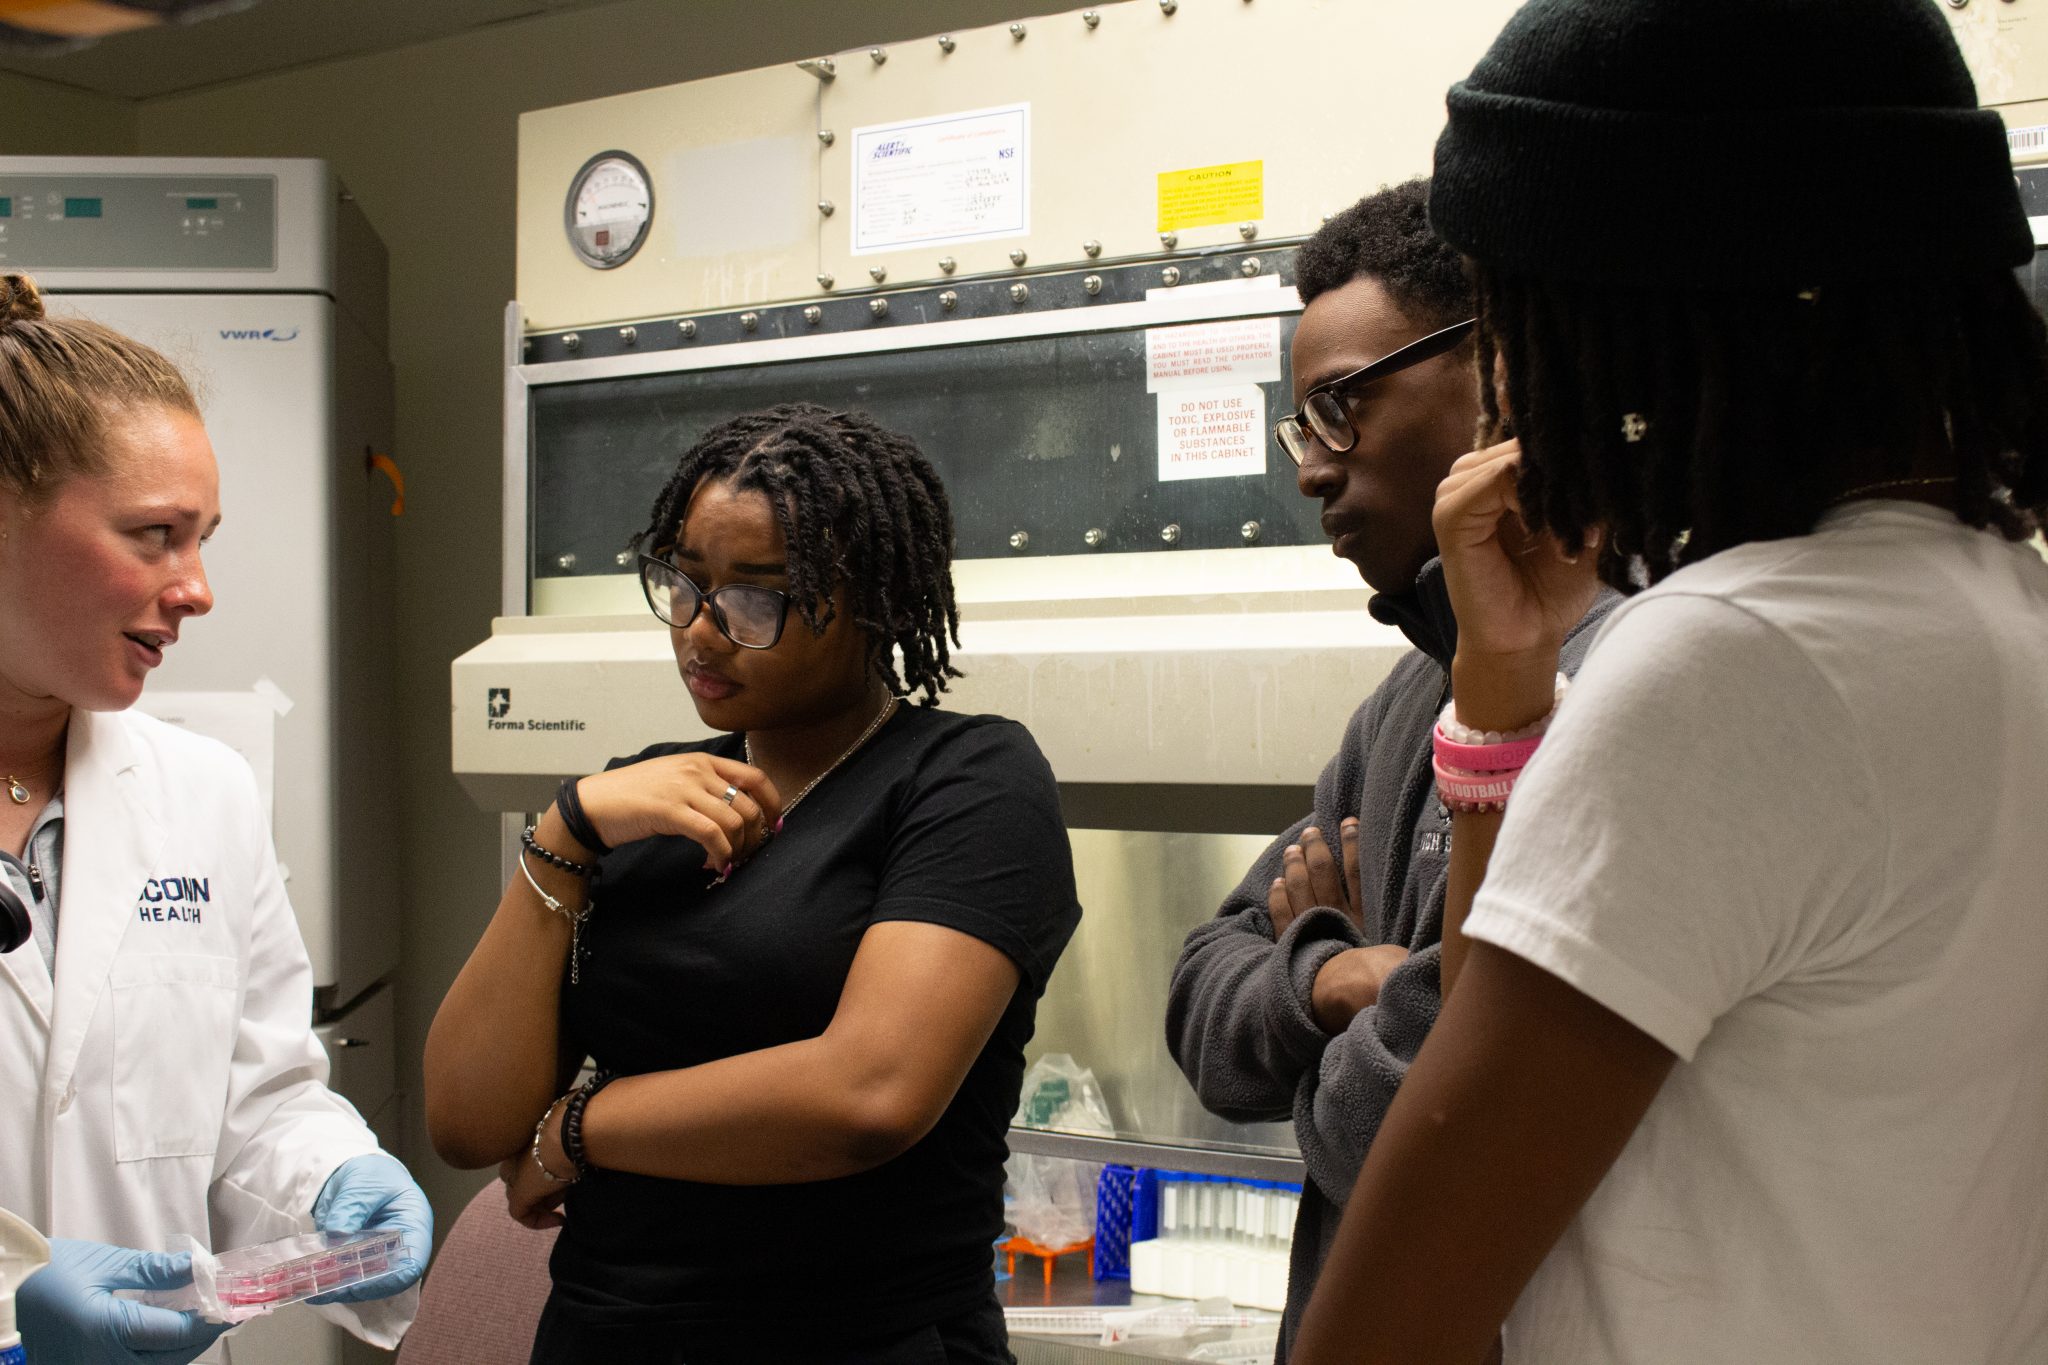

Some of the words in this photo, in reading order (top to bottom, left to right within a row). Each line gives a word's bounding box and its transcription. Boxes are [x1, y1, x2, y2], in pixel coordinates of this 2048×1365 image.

[998, 147, 1015, 160] NSF
[1188, 170, 1232, 182] CAUTION
[220, 330, 260, 340] VWR
[1152, 351, 1181, 360] CABINET
[1183, 349, 1202, 358] MUST
[1205, 347, 1214, 355] BE
[1216, 346, 1234, 354] USED
[1152, 361, 1167, 369] YOU
[1170, 358, 1190, 368] MUST
[1193, 357, 1211, 366] READ
[1215, 355, 1229, 363] THE
[1232, 351, 1273, 362] OPERATORS
[1153, 369, 1182, 379] MANUAL
[1183, 366, 1209, 376] BEFORE
[1181, 402, 1195, 413] DO
[1198, 400, 1219, 411] NOT
[1222, 398, 1243, 409] USE
[1203, 409, 1256, 423] EXPLOSIVE
[1173, 427, 1187, 438] OR
[1190, 422, 1251, 436] FLAMMABLE
[1179, 435, 1245, 450] SUBSTANCES
[1170, 453, 1181, 463] IN
[1185, 450, 1208, 462] THIS
[488, 719, 525, 731] Forma
[527, 719, 586, 731] Scientific
[1448, 780, 1511, 799] FOOTBALL
[139, 876, 210, 903] CONN
[139, 905, 201, 924] HEALTH
